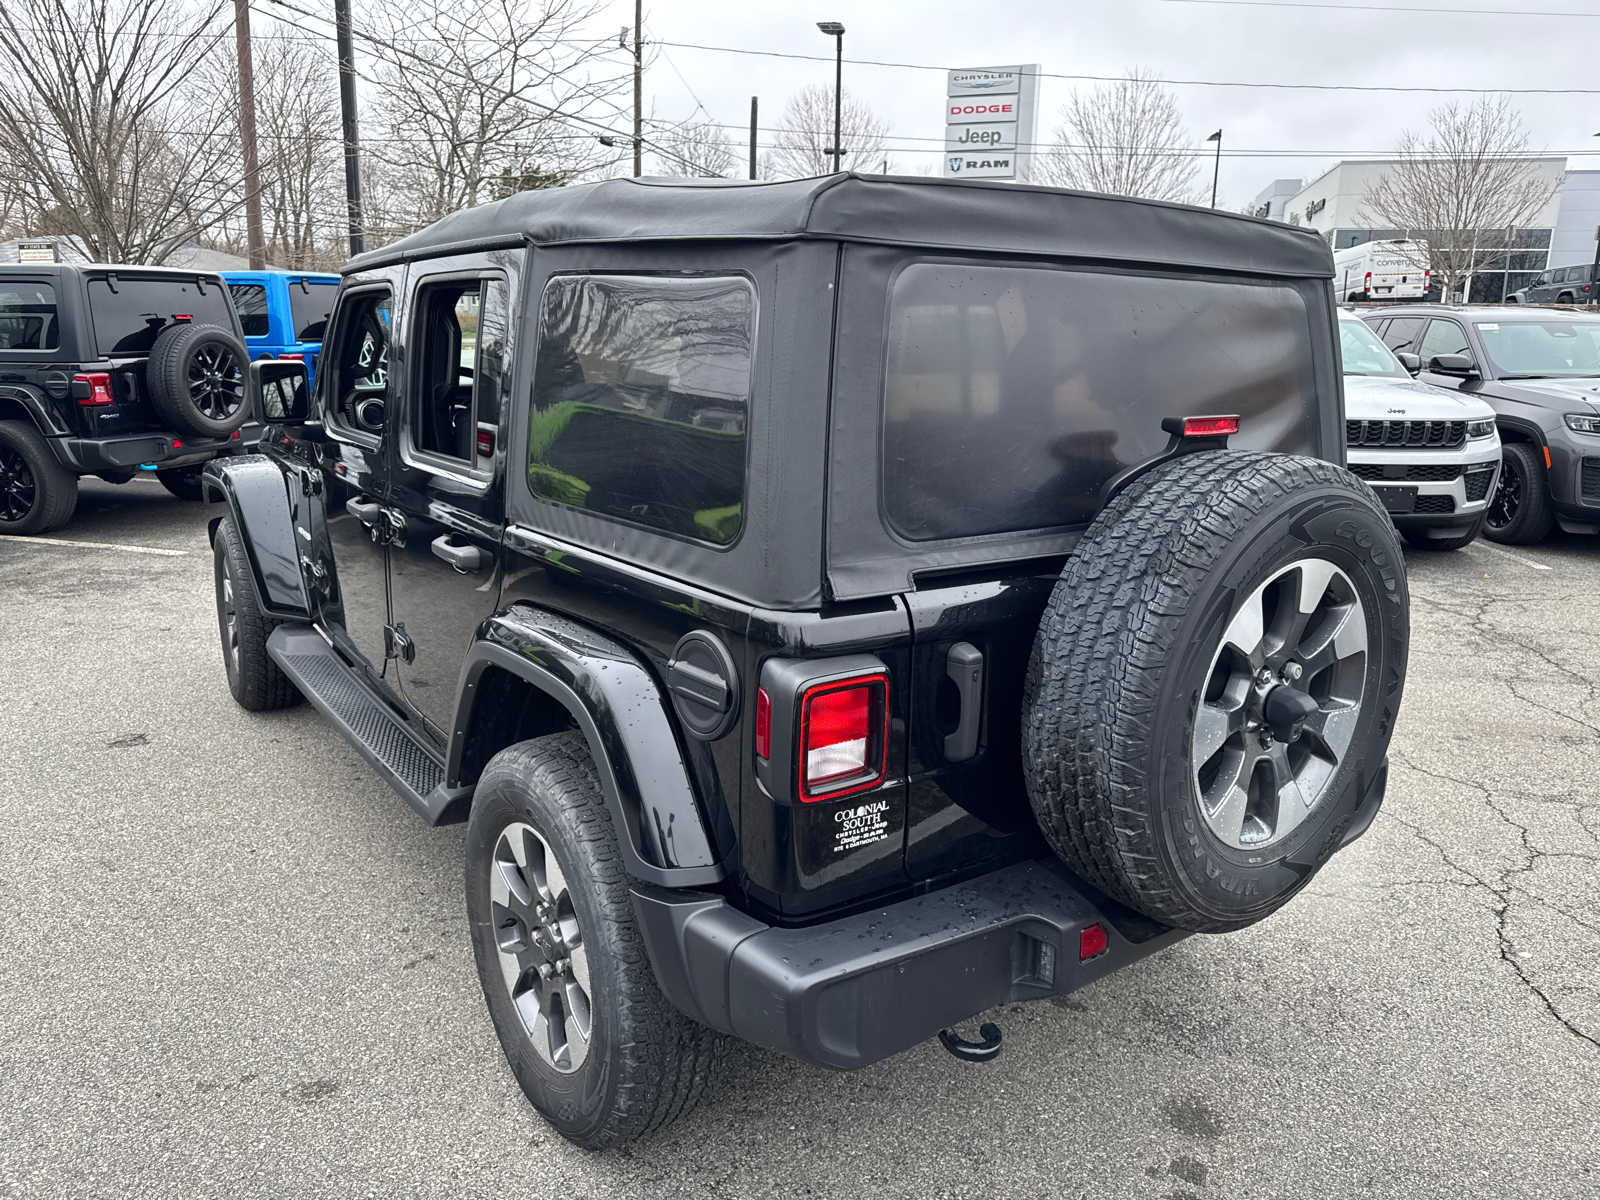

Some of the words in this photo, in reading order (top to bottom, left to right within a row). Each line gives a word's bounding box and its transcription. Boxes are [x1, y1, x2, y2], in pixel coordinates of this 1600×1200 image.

[953, 73, 1013, 81] CHRYSLER
[950, 104, 1013, 115] DODGE
[958, 128, 1002, 146] Jeep
[966, 160, 1009, 169] RAM
[1335, 519, 1402, 738] GOODYEAR
[835, 801, 889, 822] COLONIAL
[843, 812, 881, 831] SOUTH
